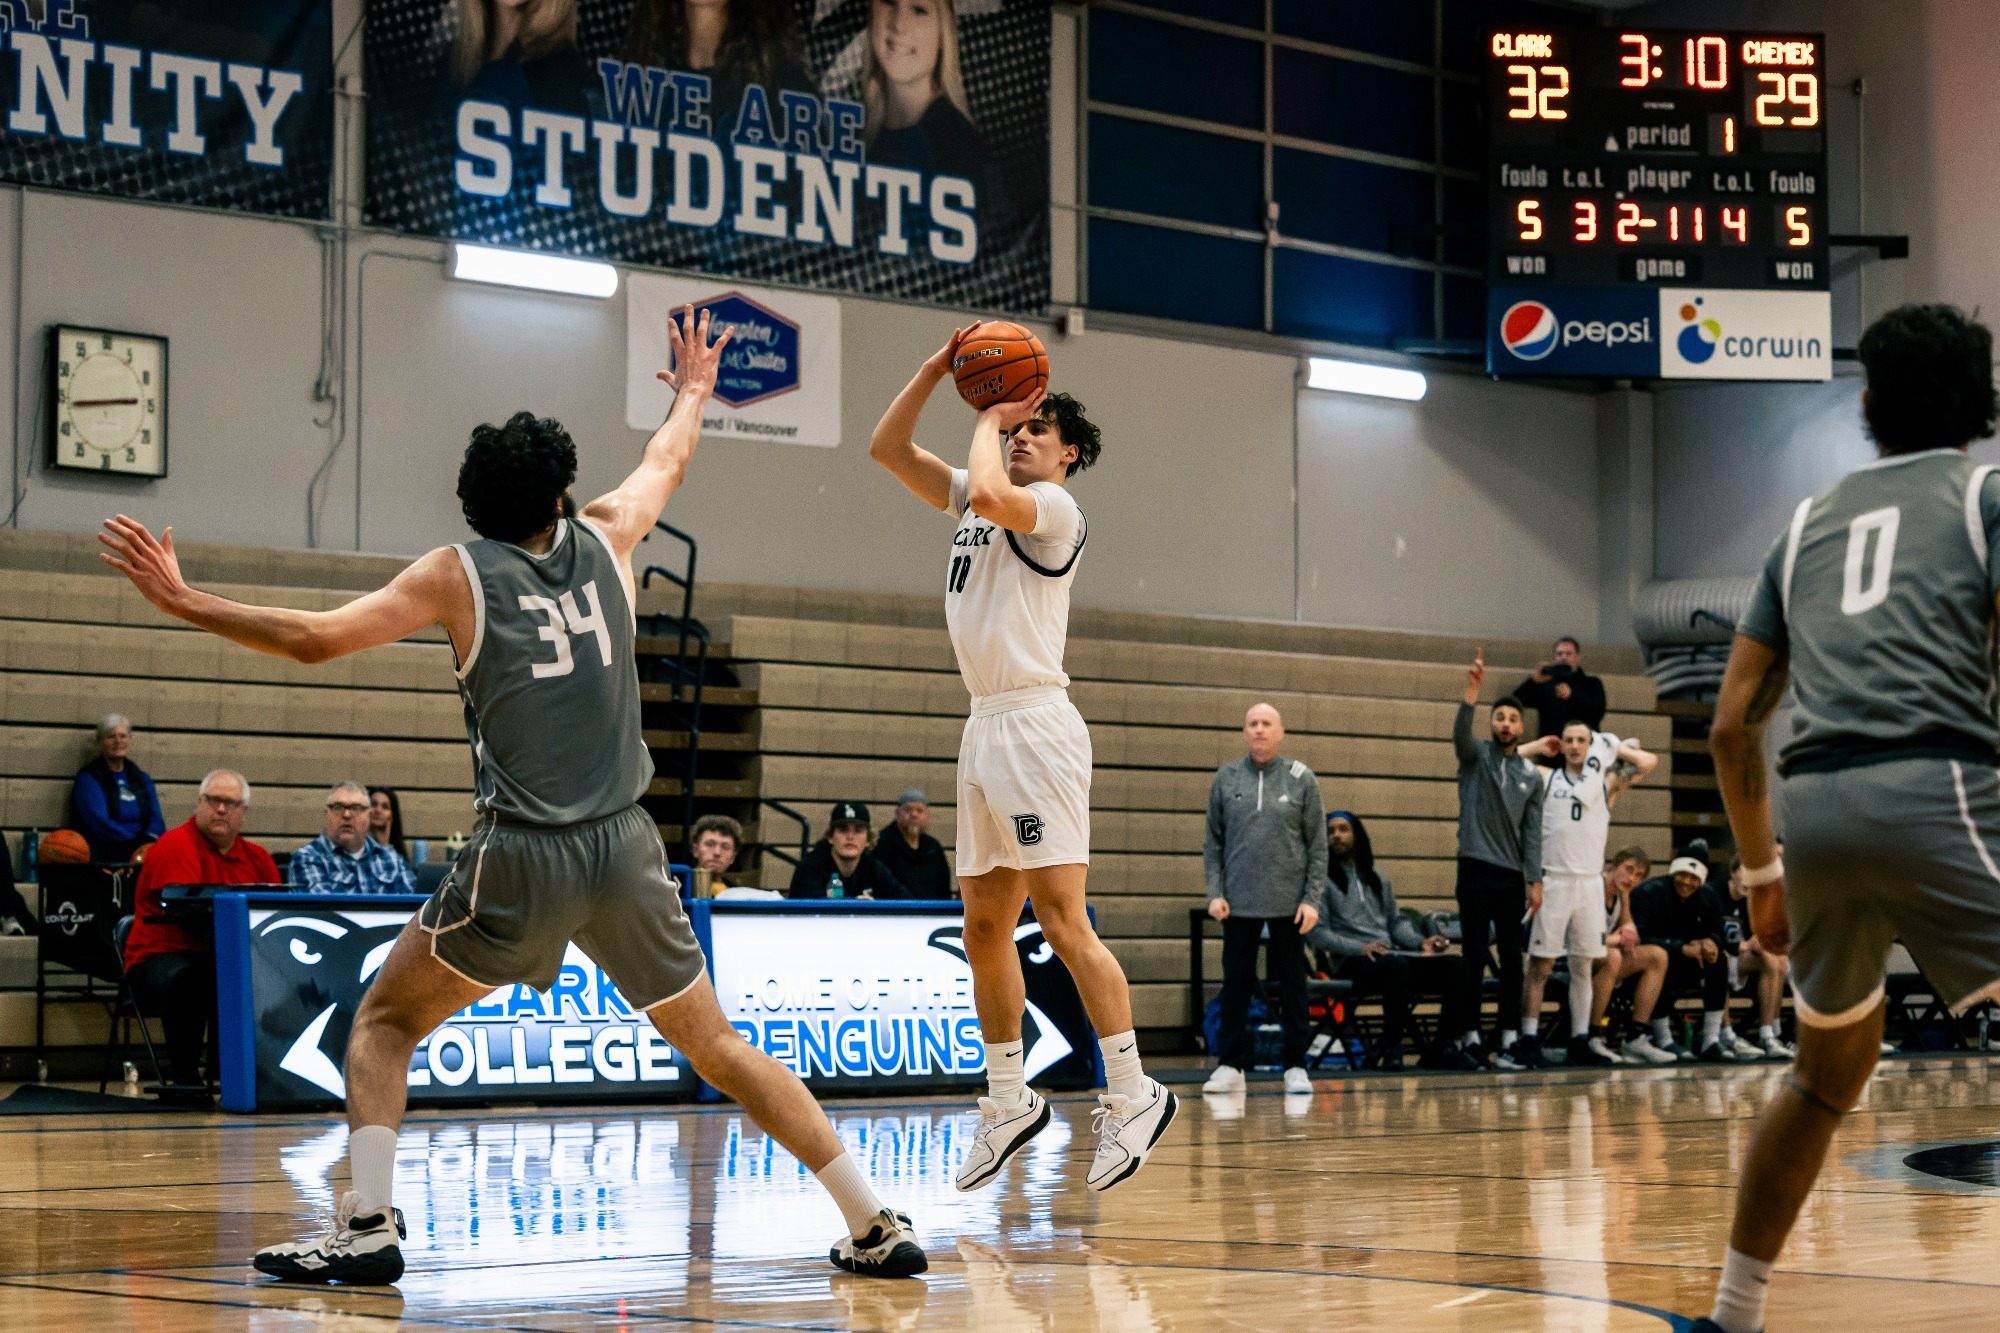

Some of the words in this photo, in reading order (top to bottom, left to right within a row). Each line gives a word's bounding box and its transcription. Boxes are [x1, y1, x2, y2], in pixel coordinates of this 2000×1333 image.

[1492, 33, 1553, 58] CLARK
[1743, 40, 1815, 66] CHEMEK
[1620, 34, 1728, 89] 3:10
[1507, 65, 1569, 120] 32
[1756, 72, 1819, 127] 29
[597, 57, 712, 138] WE
[730, 83, 866, 167] ARE
[1626, 124, 1691, 150] period
[1724, 117, 1735, 153] 1
[455, 99, 979, 265] STUDENTS
[1501, 163, 1548, 188] fouls
[1627, 164, 1692, 193] player
[1770, 169, 1816, 194] fouls
[1517, 200, 1543, 240] 5
[1575, 201, 1597, 241] 3
[1723, 207, 1746, 243] 4
[1786, 206, 1810, 246] 5
[1507, 256, 1546, 275] won
[1636, 258, 1686, 282] game
[1775, 261, 1814, 280] won
[1563, 317, 1650, 348] pepsi
[1723, 332, 1822, 359] corwin
[734, 419, 798, 437] Vancouver
[948, 554, 972, 594] 10
[1840, 505, 1901, 616] 0
[517, 579, 613, 680] 34
[1571, 802, 1582, 821] 0
[737, 972, 836, 1012] HOME
[848, 972, 892, 1012] OF
[902, 970, 971, 1011] THE
